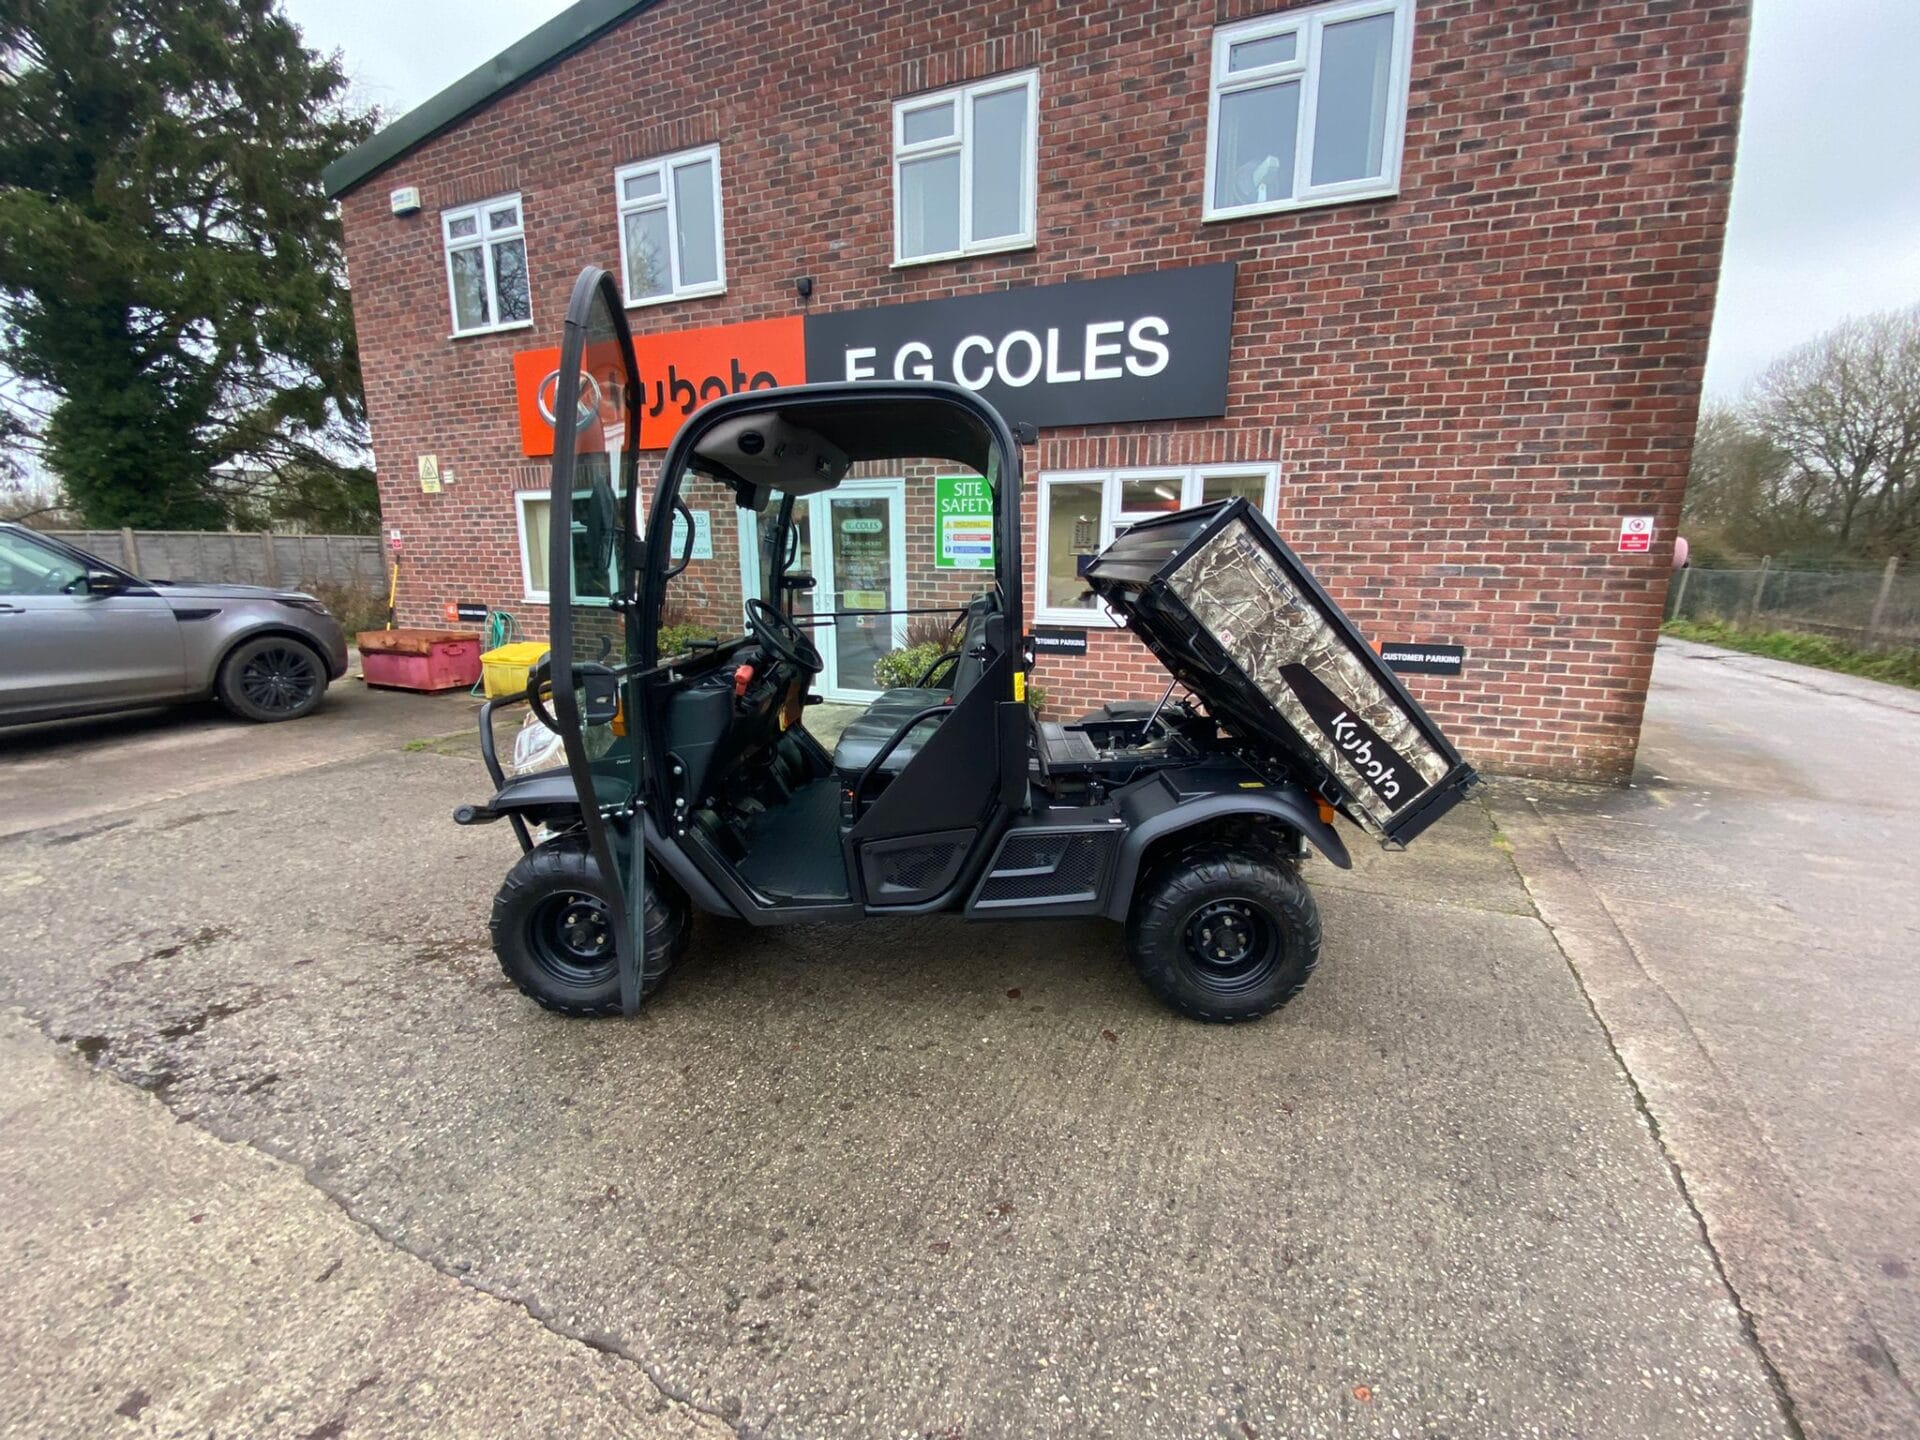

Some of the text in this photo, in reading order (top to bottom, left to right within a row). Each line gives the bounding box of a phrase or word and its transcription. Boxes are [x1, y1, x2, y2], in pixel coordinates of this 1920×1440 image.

[952, 316, 1170, 391] COLES
[953, 482, 983, 497] SITE
[941, 498, 994, 513] SAFETY
[1235, 533, 1298, 607] DIESEL
[1060, 638, 1086, 647] PARKING
[1382, 652, 1461, 664] CUSTOMER PARKING
[1331, 711, 1401, 800] Kubota
